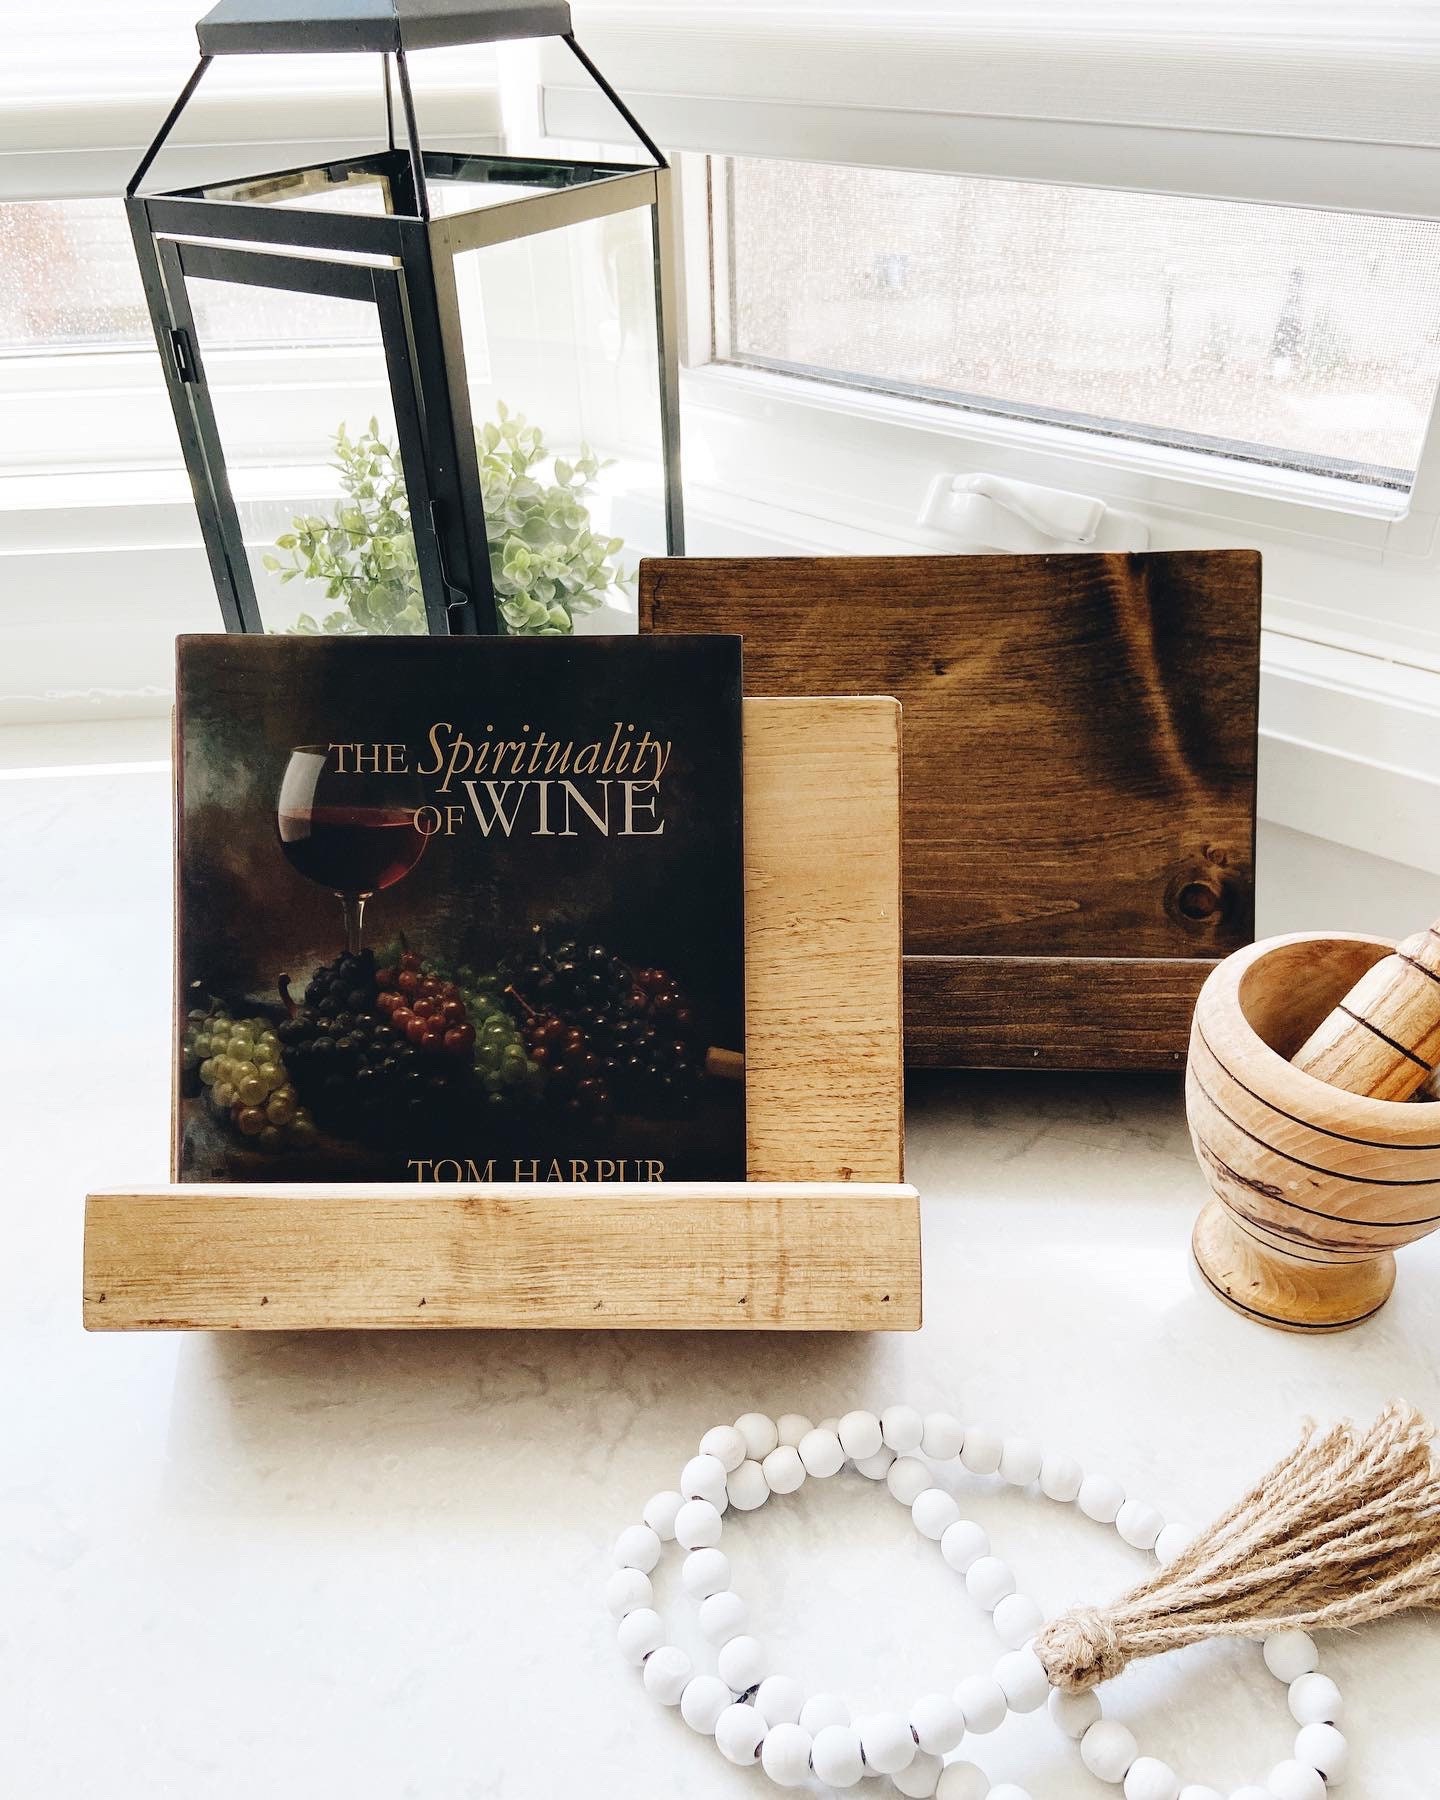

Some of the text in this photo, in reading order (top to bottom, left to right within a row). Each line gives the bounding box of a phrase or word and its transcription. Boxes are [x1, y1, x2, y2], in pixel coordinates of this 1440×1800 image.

[328, 722, 672, 793] THE Spirituality
[413, 780, 665, 838] OF WINE
[407, 1158, 666, 1183] TOM HARPUR
